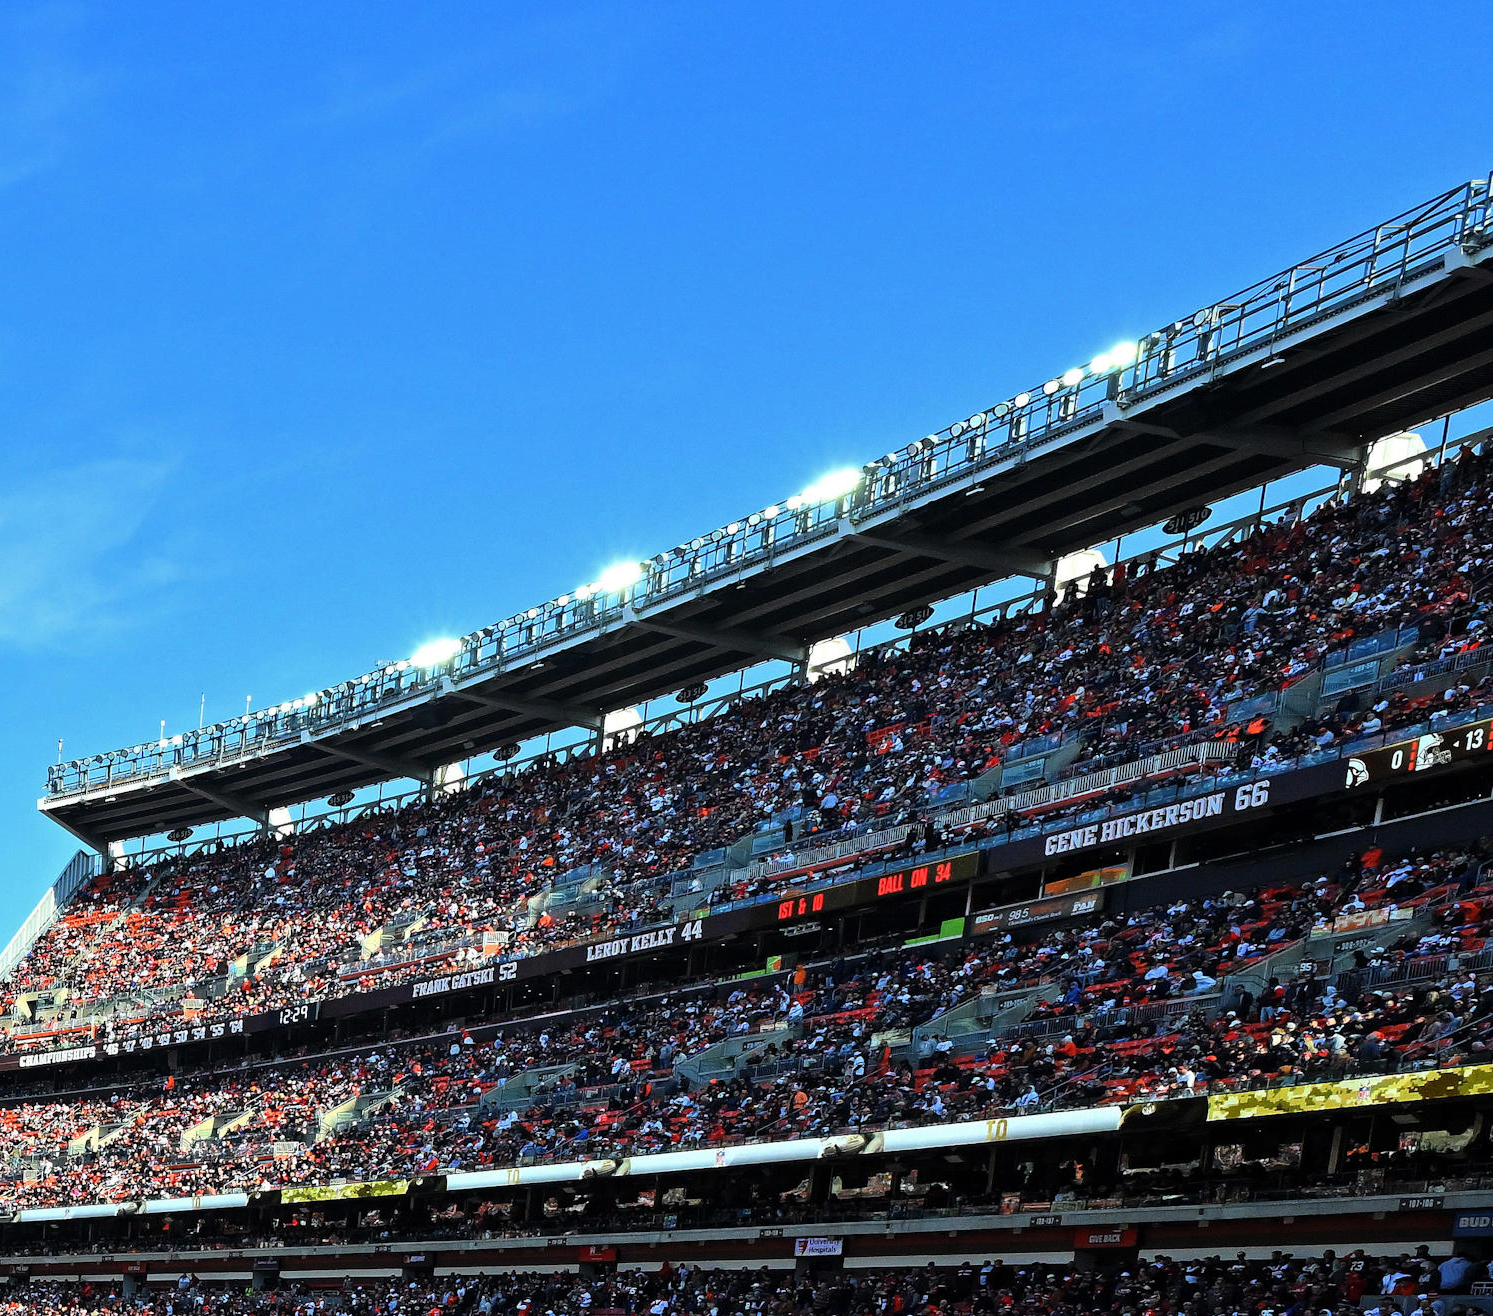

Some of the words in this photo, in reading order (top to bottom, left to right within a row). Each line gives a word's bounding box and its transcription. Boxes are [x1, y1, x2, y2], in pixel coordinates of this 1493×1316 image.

[1465, 728, 1484, 750] 13
[1391, 750, 1403, 770] 0
[1045, 824, 1099, 856] GENE
[1099, 793, 1225, 843] HICKERSON
[1234, 780, 1271, 811] 66
[877, 876, 903, 896] BALL
[911, 869, 928, 889] ON
[935, 862, 952, 881] 34
[778, 900, 795, 920] 1ST
[798, 898, 807, 914] &
[812, 893, 824, 911] 10
[586, 938, 630, 962] LEROY
[631, 927, 677, 952] KELLY
[681, 919, 703, 941] 44
[412, 976, 451, 998] FRANK
[451, 966, 494, 990] GATSKI
[499, 962, 518, 982] 52
[19, 1047, 96, 1068] CHAMPIONSHIPS
[986, 1119, 1008, 1141] TO
[1459, 1217, 1490, 1228] BUD
